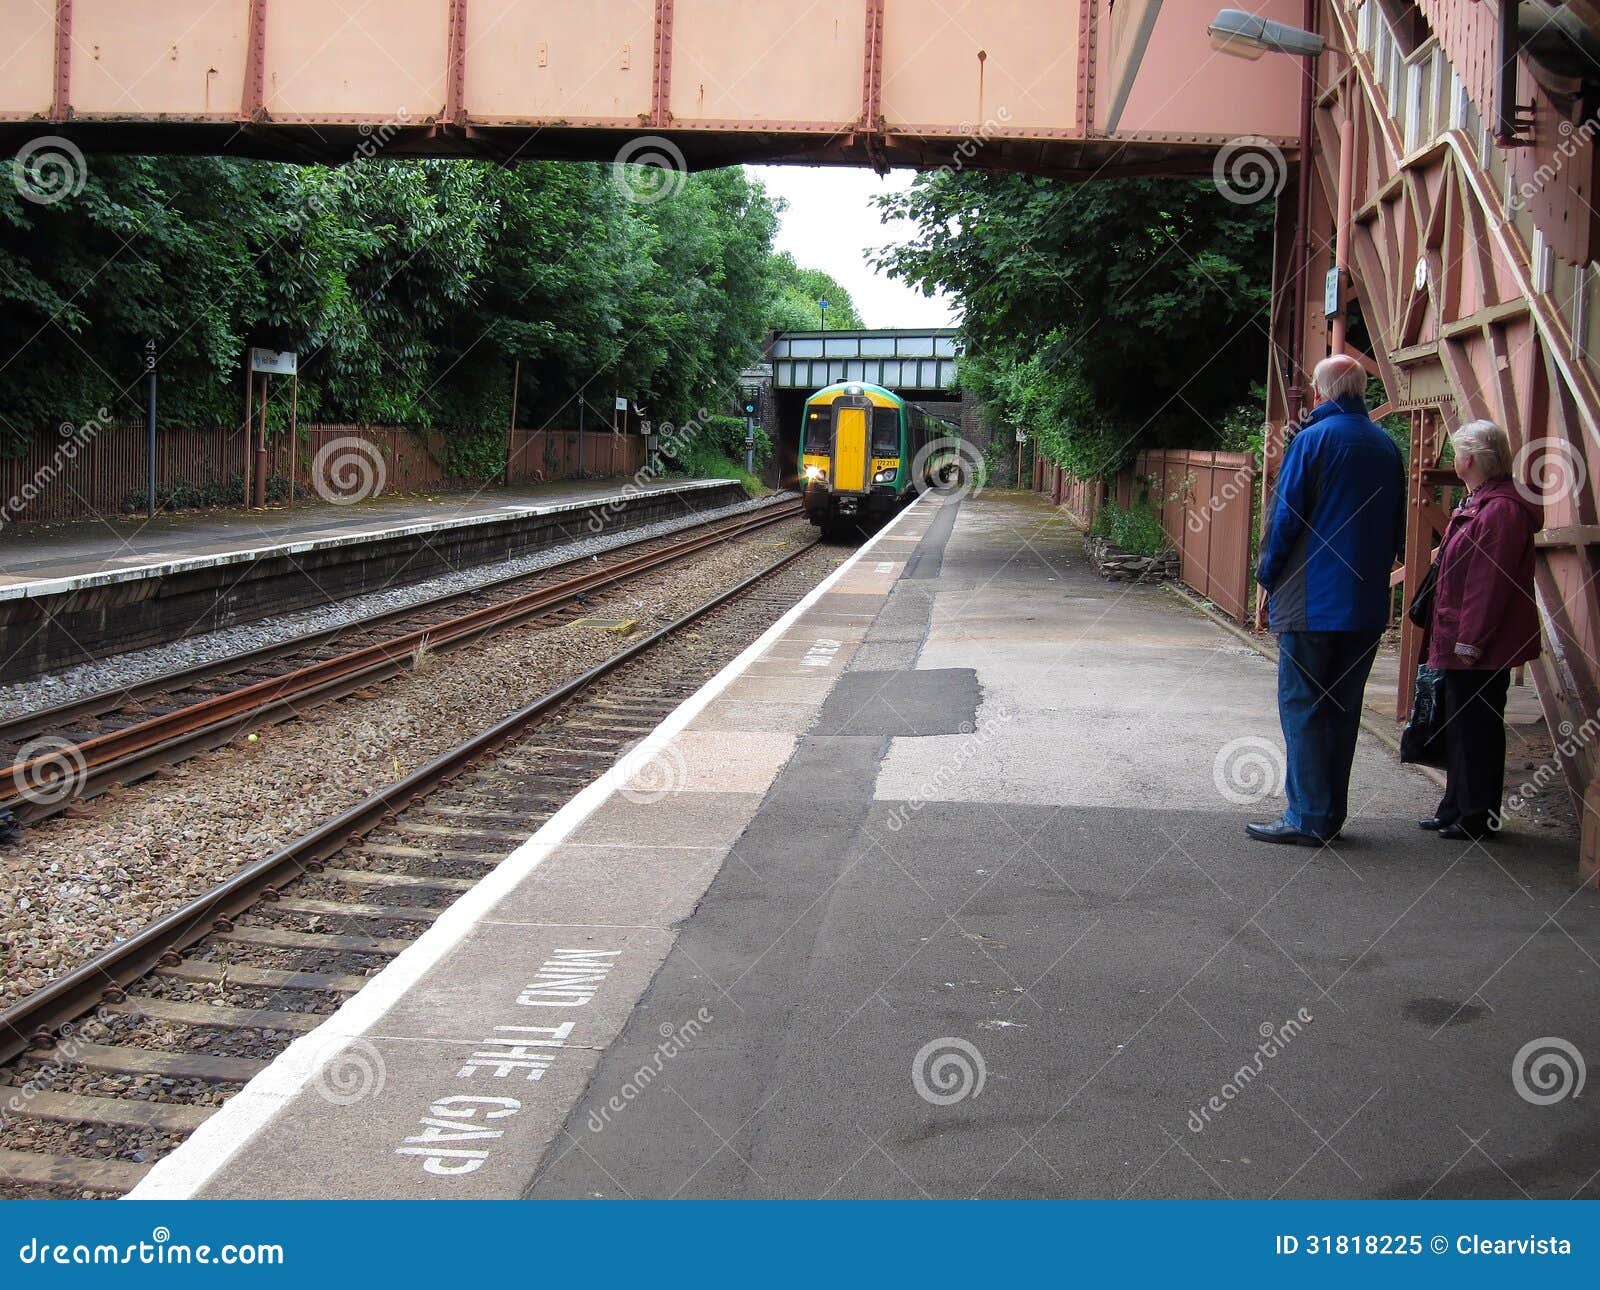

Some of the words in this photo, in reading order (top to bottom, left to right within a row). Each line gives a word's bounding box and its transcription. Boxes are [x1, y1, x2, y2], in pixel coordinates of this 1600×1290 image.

[145, 338, 156, 351] 4
[146, 356, 155, 369] 3
[516, 948, 622, 1007] MIND
[456, 1022, 576, 1081] THE
[395, 1096, 521, 1175] GAP
